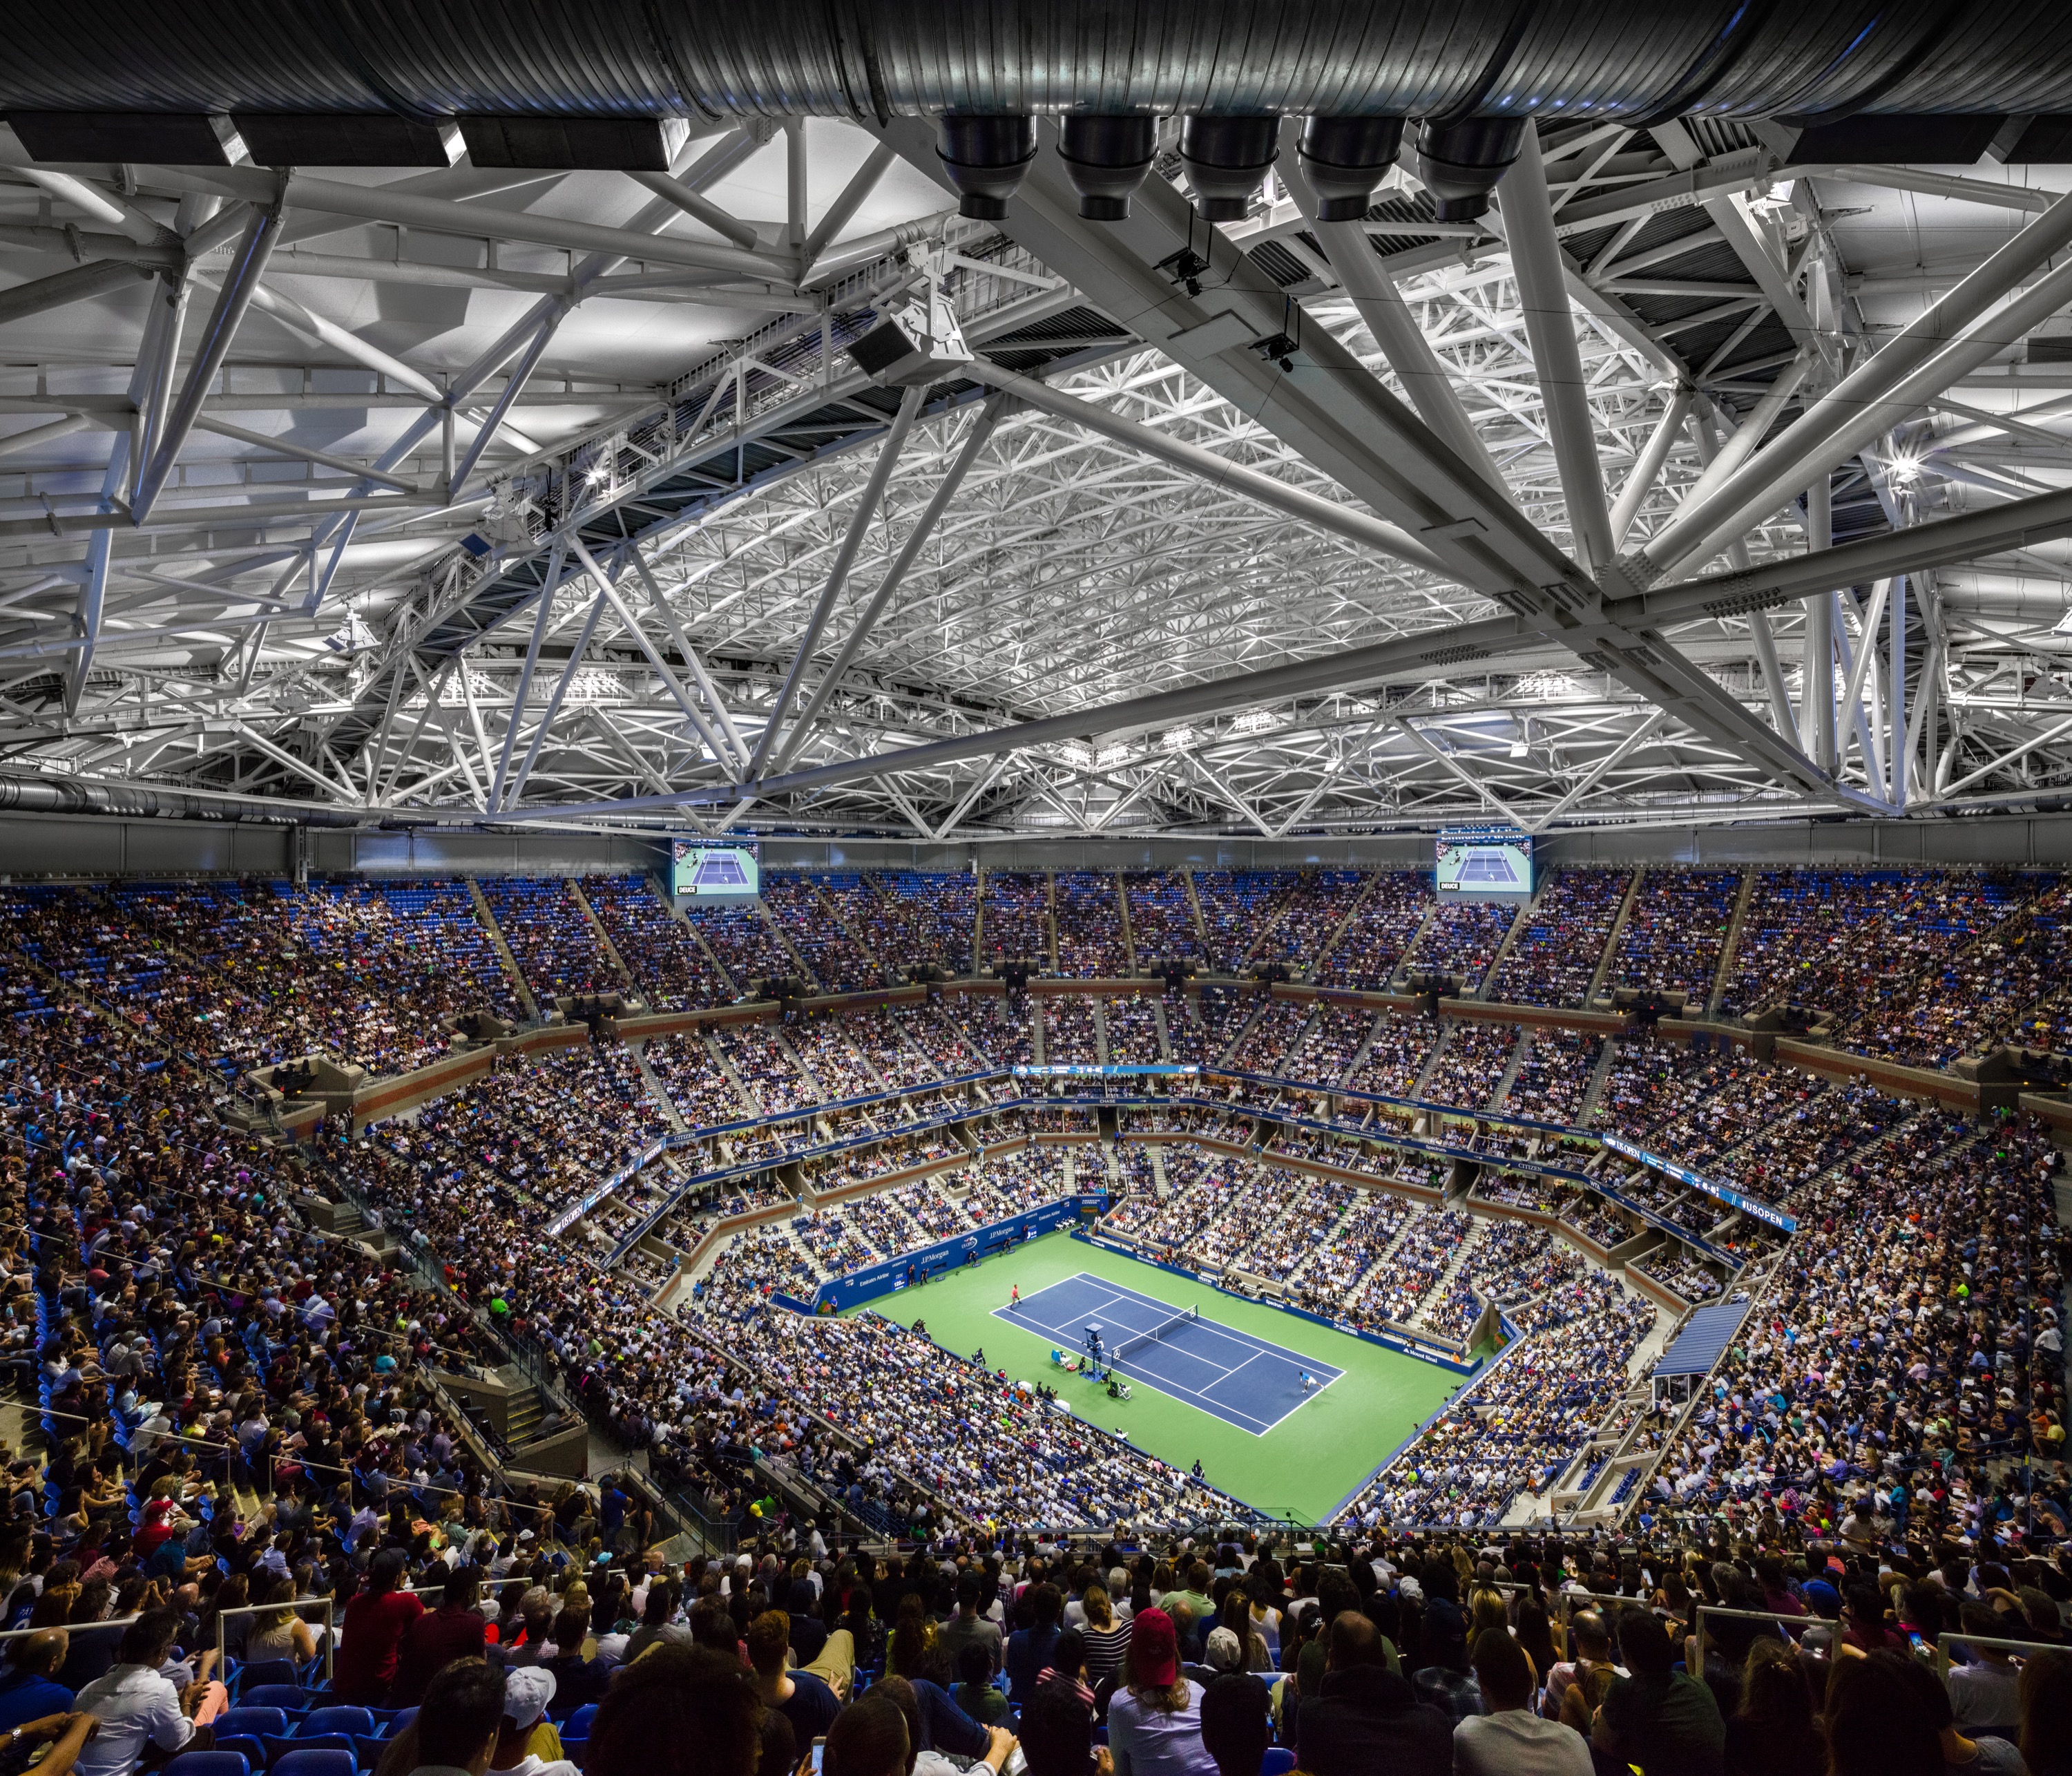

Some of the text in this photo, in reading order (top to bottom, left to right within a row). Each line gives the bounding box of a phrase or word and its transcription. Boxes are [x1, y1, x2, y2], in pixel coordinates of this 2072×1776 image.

[674, 1132, 696, 1141] CITIZEN
[1565, 1127, 1593, 1137] usopen.org
[1616, 1141, 1640, 1159] US OPEN
[725, 1163, 760, 1175] AMERICAN EXPRESS
[1518, 1163, 1542, 1172] CITIZEN
[1590, 1180, 1601, 1190] WTA
[1702, 1182, 1708, 1190] 40
[1710, 1185, 1716, 1194] 40
[562, 1204, 583, 1228] US OPEN
[1640, 1209, 1661, 1223] ticketmaster
[1742, 1201, 1783, 1226] #USOPEN
[989, 1226, 1014, 1239] J.P.Morgan
[604, 1256, 612, 1268] ATP
[921, 1250, 949, 1264] J.P.Morgan
[860, 1272, 890, 1287] Emirates Airline
[1265, 1299, 1284, 1309] Spectrum
[1410, 1349, 1437, 1364] Mount Sinai
